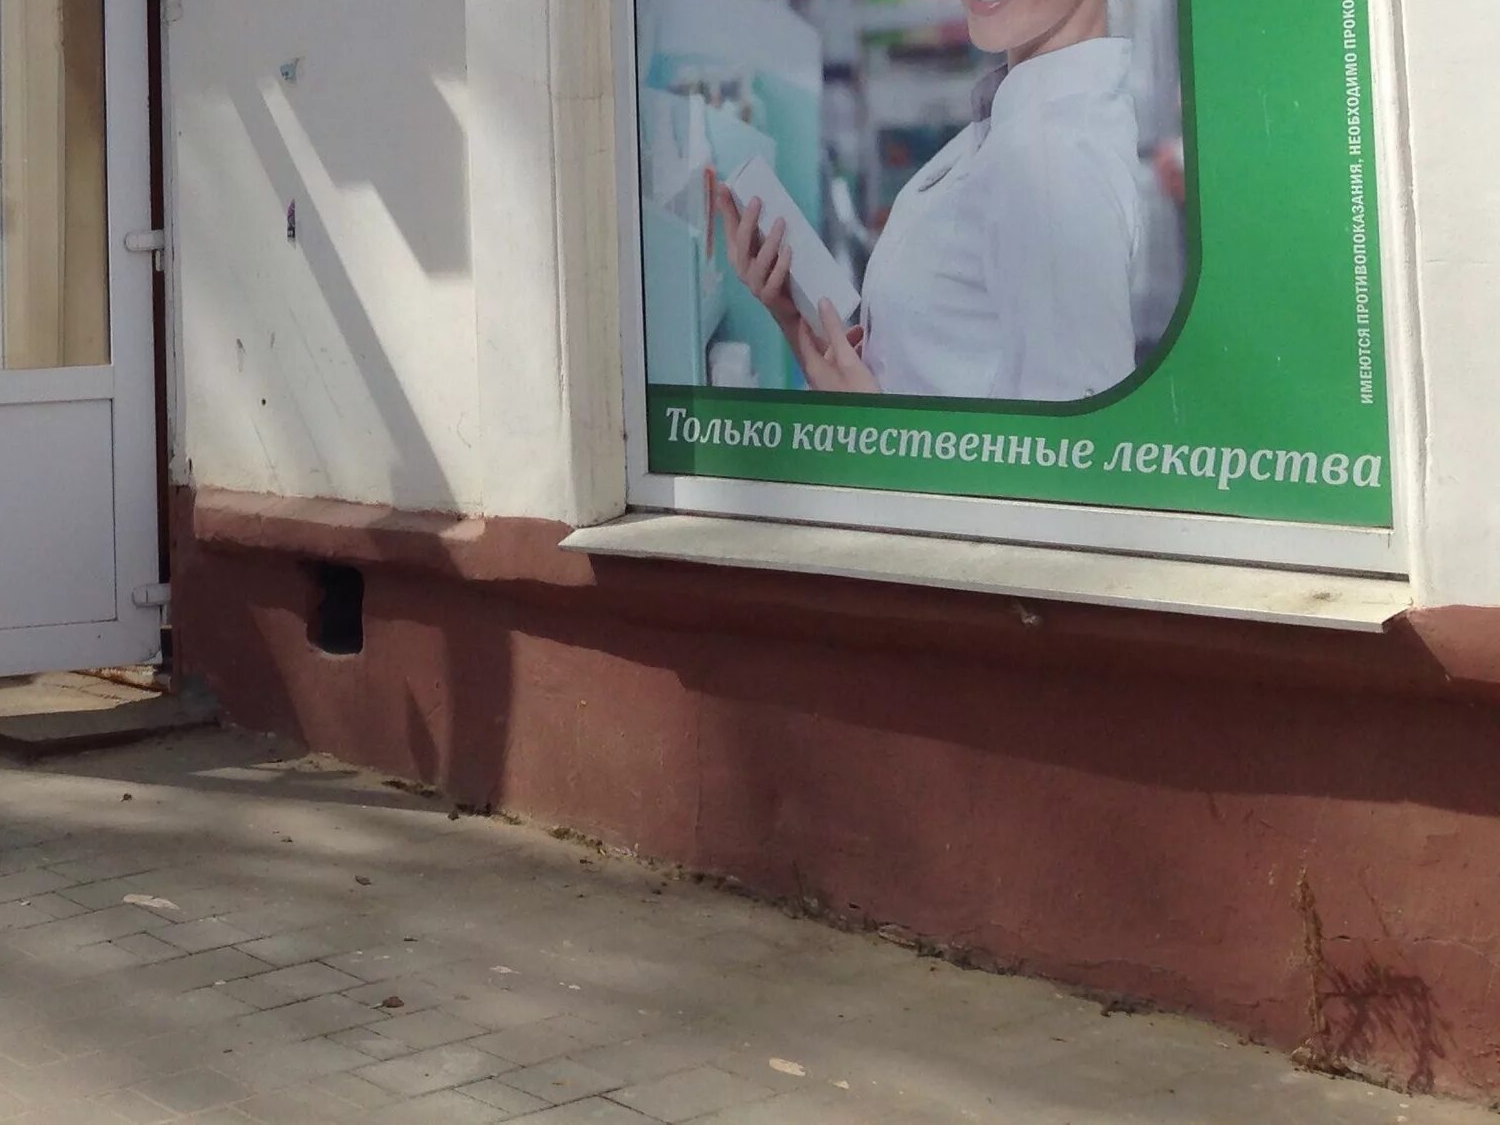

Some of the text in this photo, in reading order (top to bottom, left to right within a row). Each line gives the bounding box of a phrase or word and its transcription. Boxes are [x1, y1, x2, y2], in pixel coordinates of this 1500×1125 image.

[1343, 53, 1362, 155] НЕОБХОДИМО
[1349, 158, 1370, 324] ПРОТИВОПОКАЗАНИЯ,
[1357, 328, 1374, 404] ИМЕЮТСЯ
[665, 407, 1382, 491] Только качественные лекарства
